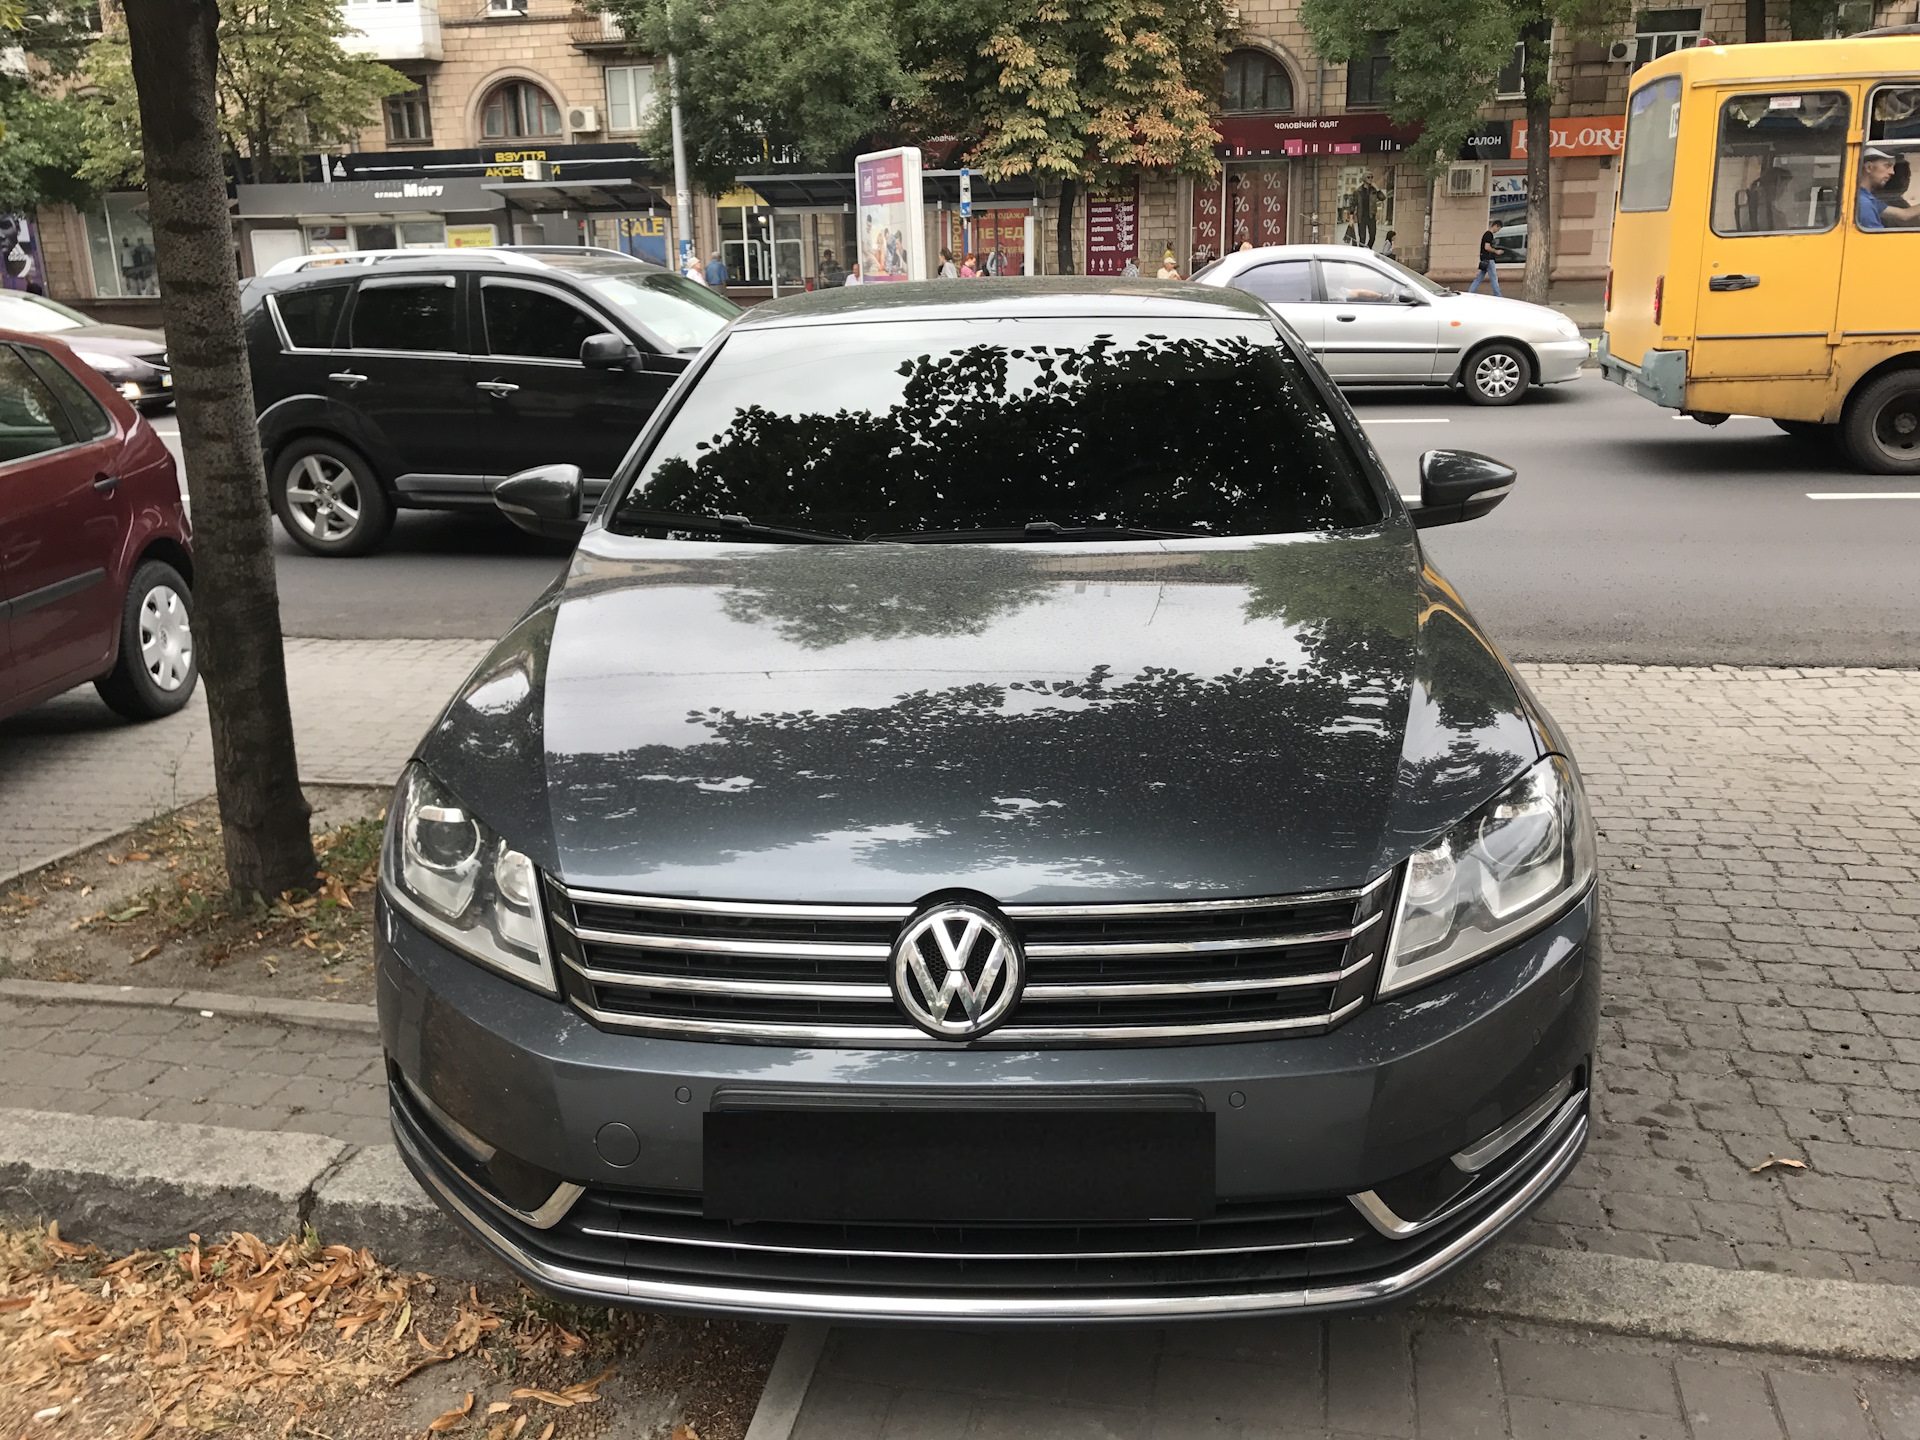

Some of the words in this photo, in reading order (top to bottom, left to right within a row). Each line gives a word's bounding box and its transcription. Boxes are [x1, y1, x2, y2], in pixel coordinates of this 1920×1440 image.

[1274, 119, 1317, 130] чоловічий
[1319, 120, 1339, 129] одяг
[1467, 136, 1502, 146] САЛОН
[494, 150, 547, 162] ВЗУТТЯ
[485, 165, 561, 177] АКСЕИ
[620, 220, 664, 237] SALE
